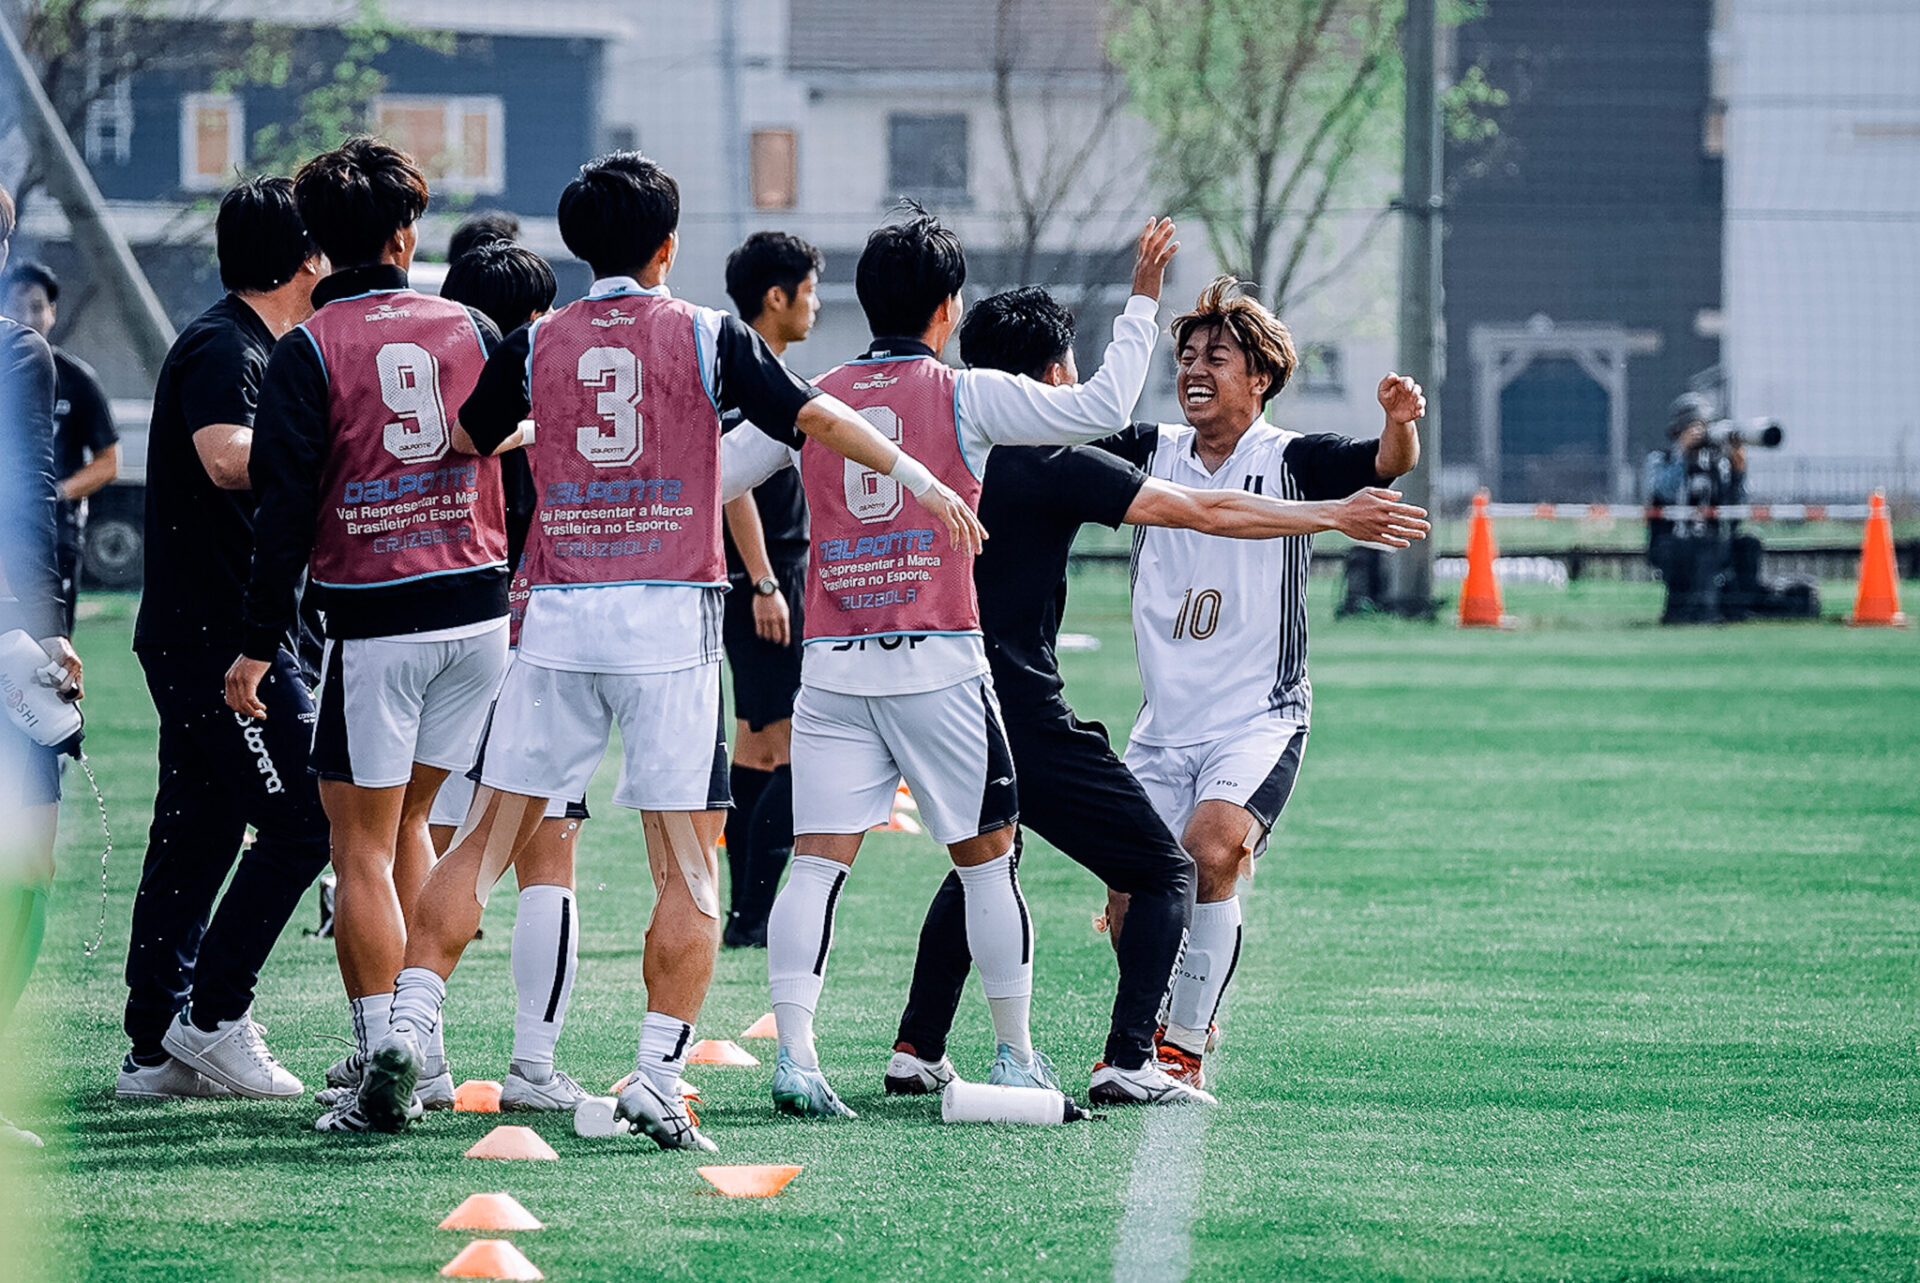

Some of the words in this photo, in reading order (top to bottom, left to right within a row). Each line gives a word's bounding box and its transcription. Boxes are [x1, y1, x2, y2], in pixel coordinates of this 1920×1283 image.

[376, 342, 450, 464] 9
[576, 346, 643, 468] 3
[336, 507, 357, 520] Vai
[361, 496, 439, 519] Represetar
[442, 494, 452, 505] a
[639, 507, 648, 517] a
[650, 504, 694, 517] Marca
[412, 512, 427, 524] no
[605, 523, 622, 534] no
[625, 520, 683, 534] Esporte.
[897, 557, 904, 567] a
[907, 554, 941, 567] Marca
[868, 575, 884, 586] no
[887, 569, 932, 584] Esporte.
[1172, 588, 1222, 640] 10
